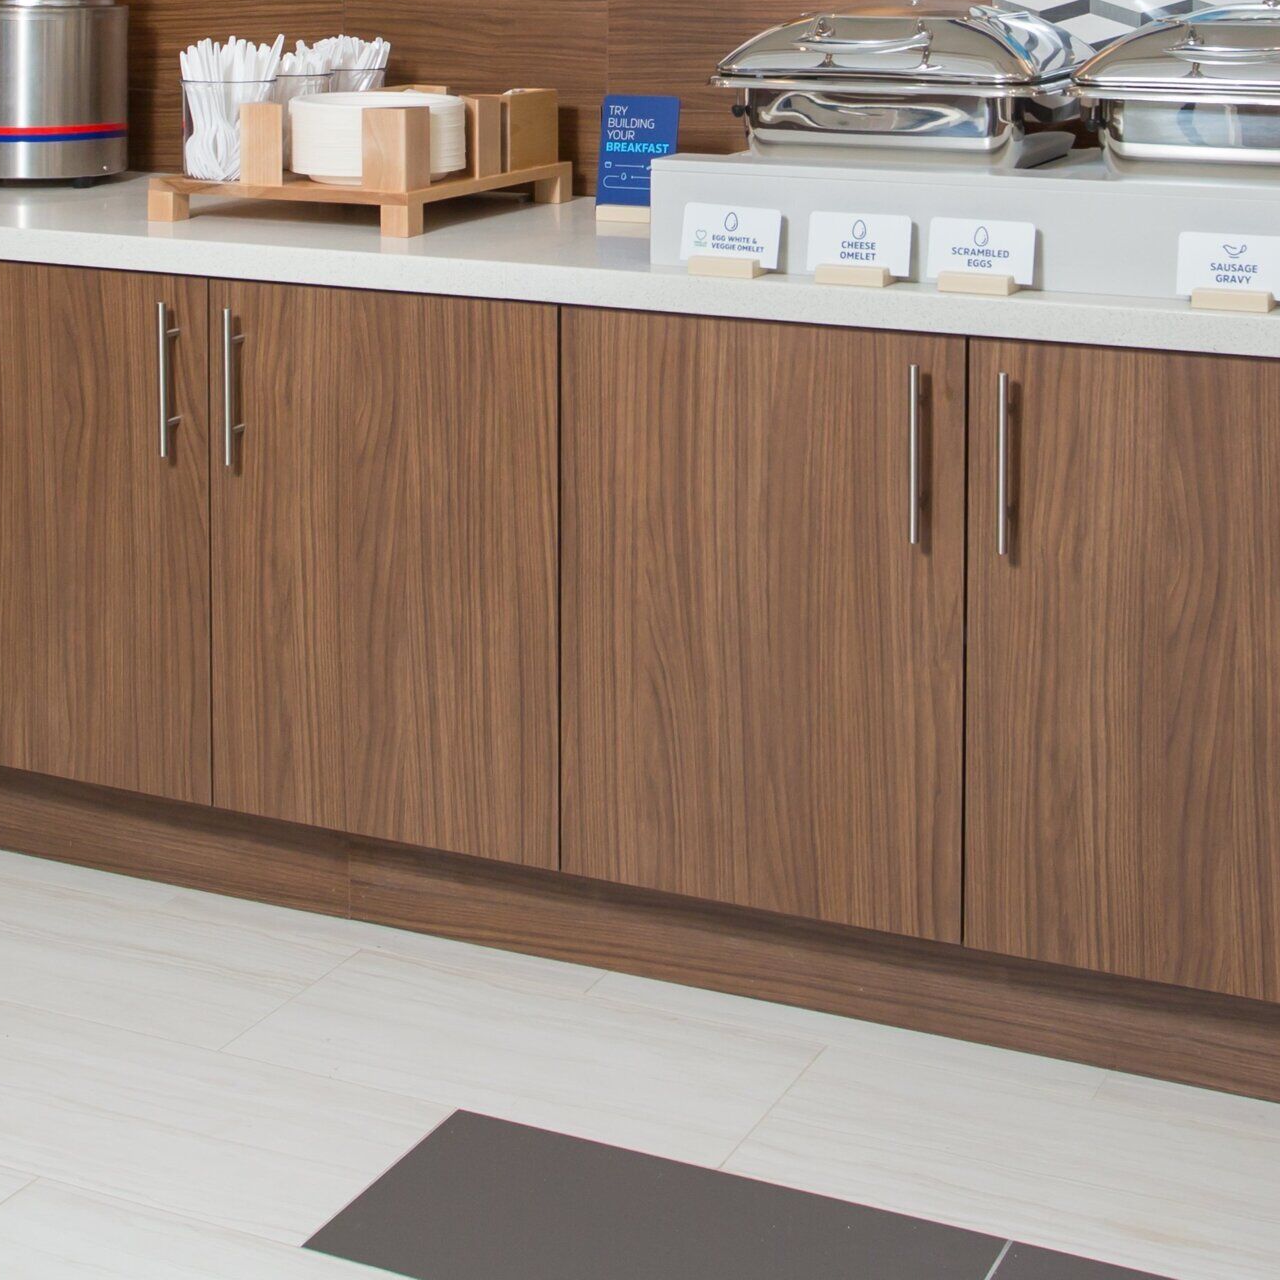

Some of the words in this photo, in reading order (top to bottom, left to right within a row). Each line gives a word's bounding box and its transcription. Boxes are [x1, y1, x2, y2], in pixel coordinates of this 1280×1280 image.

[609, 105, 629, 116] TRY
[607, 117, 655, 129] BUILDING
[607, 129, 635, 141] YOUR
[605, 141, 669, 154] BREAKFAST
[712, 234, 726, 242] EGG
[728, 236, 751, 244] WHITE
[711, 242, 735, 251] VEGGIE
[736, 244, 765, 253] OMELET
[841, 240, 876, 251] CHEESE
[839, 251, 876, 262] OMELET
[951, 246, 1010, 259] SCRAMBLED
[967, 259, 993, 269] EGGS
[1210, 262, 1258, 273] SAUSAGE
[1215, 274, 1251, 284] GRAVY
